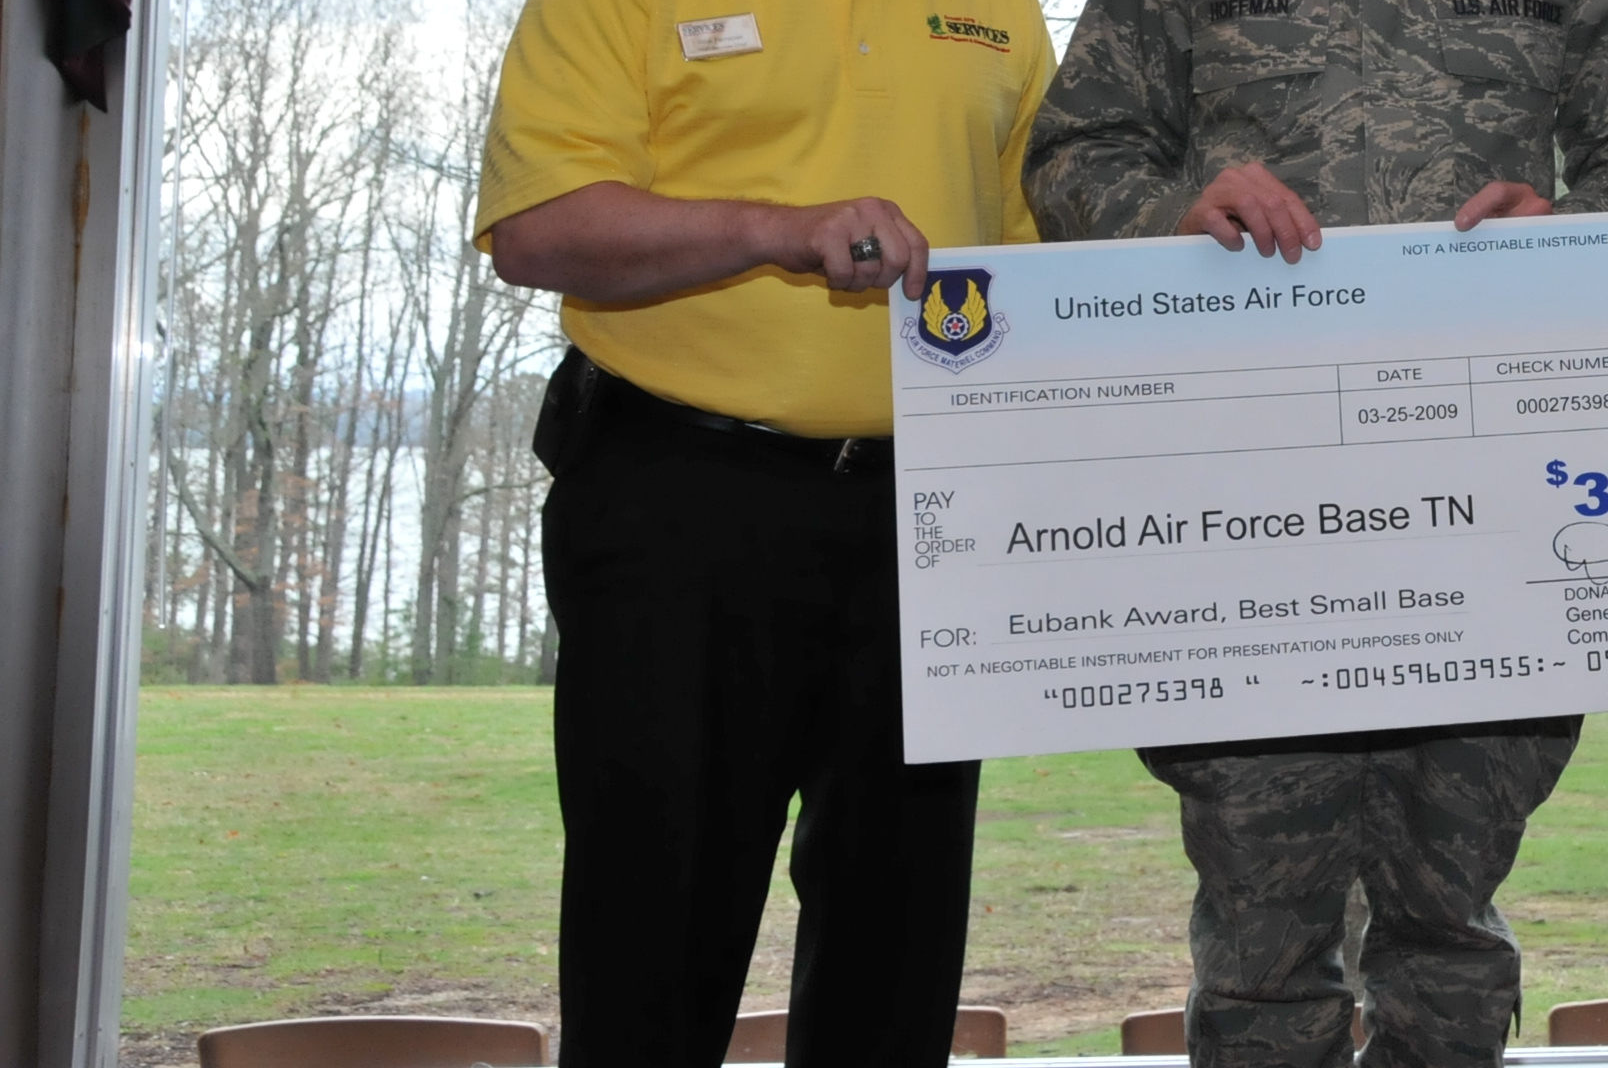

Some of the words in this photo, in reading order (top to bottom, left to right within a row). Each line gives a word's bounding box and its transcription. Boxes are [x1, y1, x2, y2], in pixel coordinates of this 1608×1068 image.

[1523, 0, 1565, 24] FORCE
[682, 22, 725, 35] SERVICES
[945, 21, 1010, 45] SERVICES
[1403, 244, 1430, 255] NOT
[1435, 244, 1445, 253] A
[1449, 238, 1533, 252] NEGOTIABLE
[1055, 294, 1142, 319] United
[1153, 292, 1235, 314] States
[1245, 287, 1282, 309] Air
[1293, 285, 1365, 307] Force
[909, 335, 919, 348] AIR
[917, 346, 940, 362] FORCE
[940, 356, 975, 369] MATERIEL
[974, 329, 1003, 358] COMMAND
[1378, 368, 1422, 382] DATE
[1497, 360, 1553, 375] CHECK
[951, 387, 1090, 405] IDENTIFICATION
[1098, 383, 1174, 398] NUMBER
[1358, 404, 1457, 424] 03-25-2009
[914, 491, 954, 510] PAY
[914, 512, 936, 525] TO
[1007, 516, 1125, 554] Arnold
[1138, 514, 1188, 545] Air
[1202, 510, 1304, 541] Force
[1317, 499, 1411, 535] Base
[1421, 495, 1473, 527] TN
[914, 526, 943, 540] THE
[915, 539, 975, 554] ORDER
[915, 555, 939, 569] OF
[1010, 610, 1113, 634] Eubank
[1124, 602, 1225, 627] Award,
[1239, 600, 1299, 619] Best
[1311, 591, 1386, 614] Small
[1399, 589, 1464, 608] Base
[921, 628, 976, 648] FOR:
[927, 664, 959, 677] NOT
[964, 664, 975, 675] A
[981, 657, 1076, 673] NEGOTIABLE
[1082, 650, 1182, 667] INSTRUMENT
[1188, 648, 1217, 660] FOR
[1223, 640, 1336, 657] PRESENTATION
[1342, 634, 1420, 649] PURPOSES
[1425, 631, 1463, 644] ONLY
